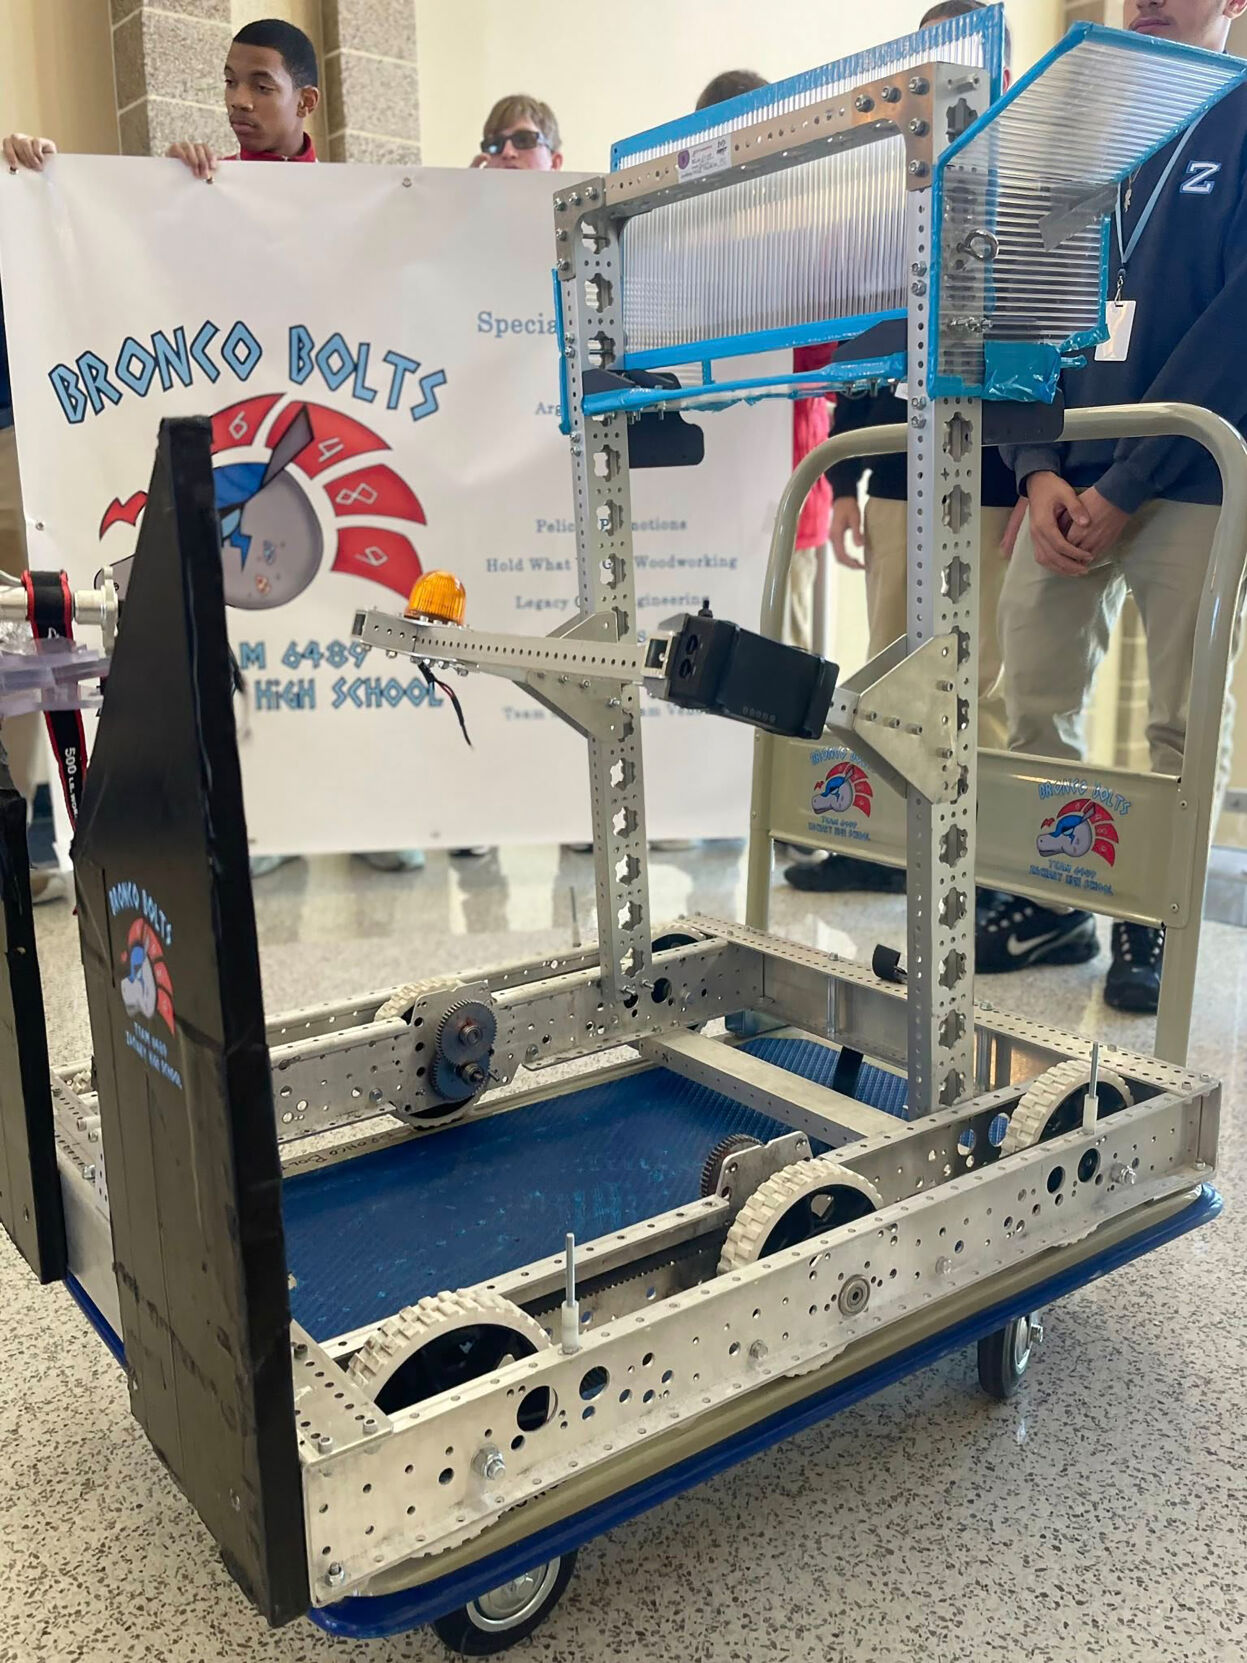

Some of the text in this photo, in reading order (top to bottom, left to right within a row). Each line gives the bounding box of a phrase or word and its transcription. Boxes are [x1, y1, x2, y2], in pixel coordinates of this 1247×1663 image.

[1180, 160, 1222, 194] Z
[477, 311, 557, 338] Specia
[48, 320, 447, 424] BRONCO BOLTS
[486, 558, 524, 572] Hold
[529, 557, 572, 571] What
[635, 555, 738, 570] Woodworking
[281, 639, 370, 670] 6489
[331, 676, 444, 709] SCHOOL
[65, 747, 77, 775] 500
